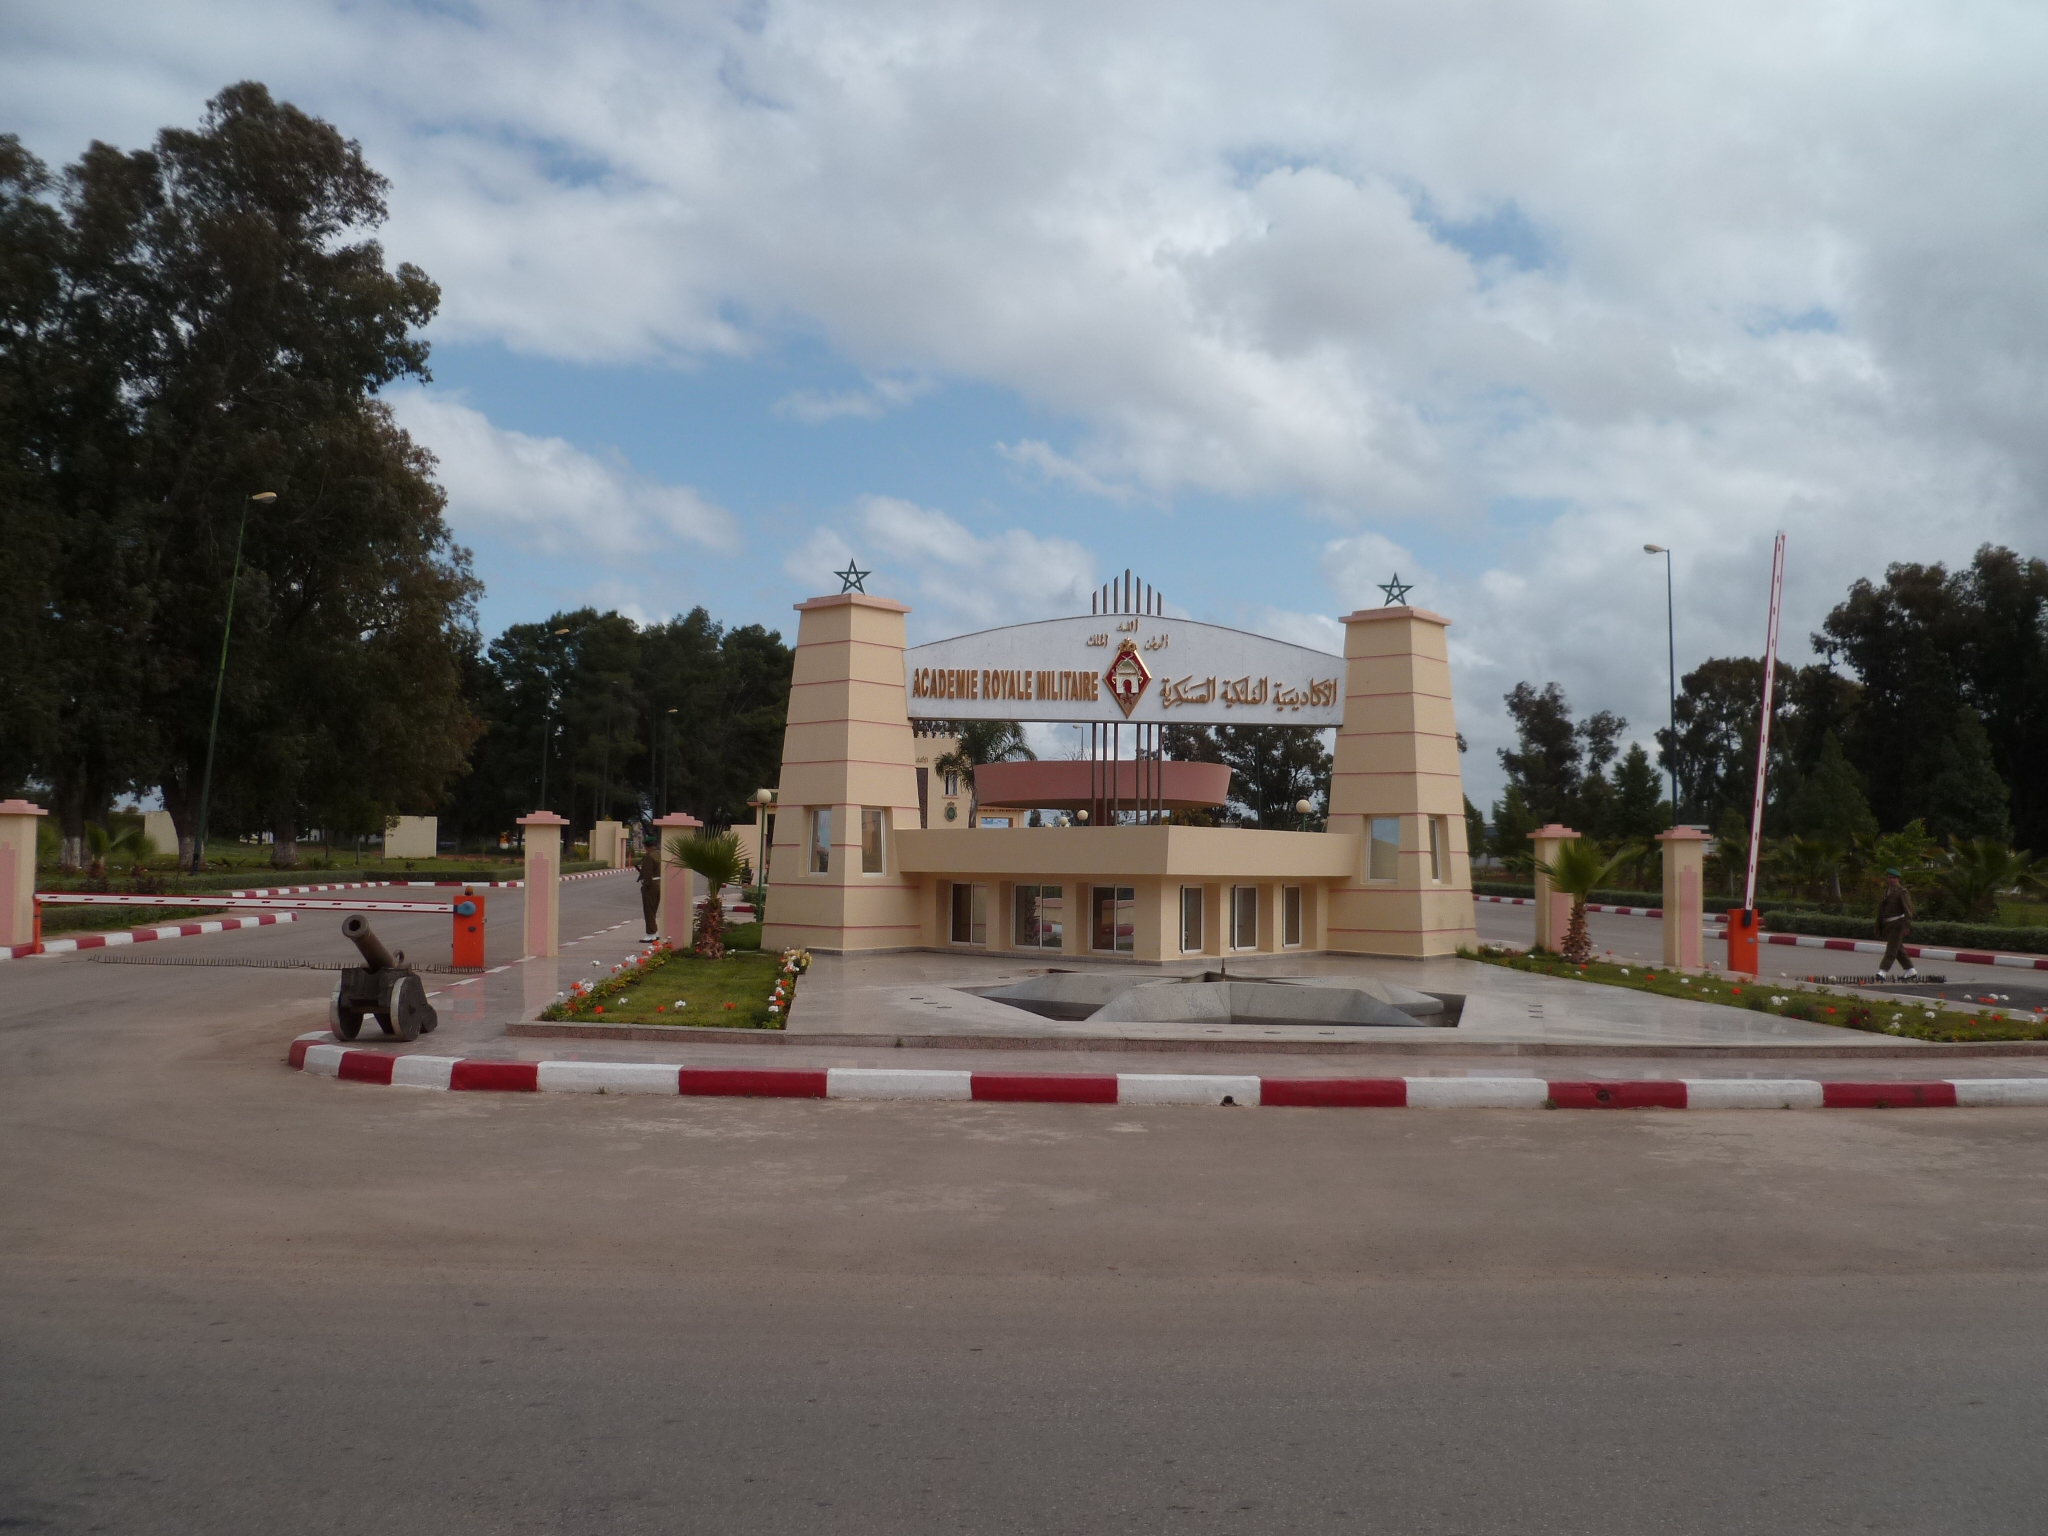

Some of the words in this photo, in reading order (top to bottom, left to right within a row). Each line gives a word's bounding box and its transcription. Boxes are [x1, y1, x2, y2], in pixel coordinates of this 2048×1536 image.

[1086, 632, 1109, 648] الملك
[1144, 634, 1169, 650] الوطن
[913, 667, 978, 699] ACADEMIE
[982, 669, 1032, 700] ROYALE
[1036, 670, 1098, 701] MILITAIRE
[1160, 675, 1216, 709] العسكرية
[1221, 675, 1267, 708] الملكية
